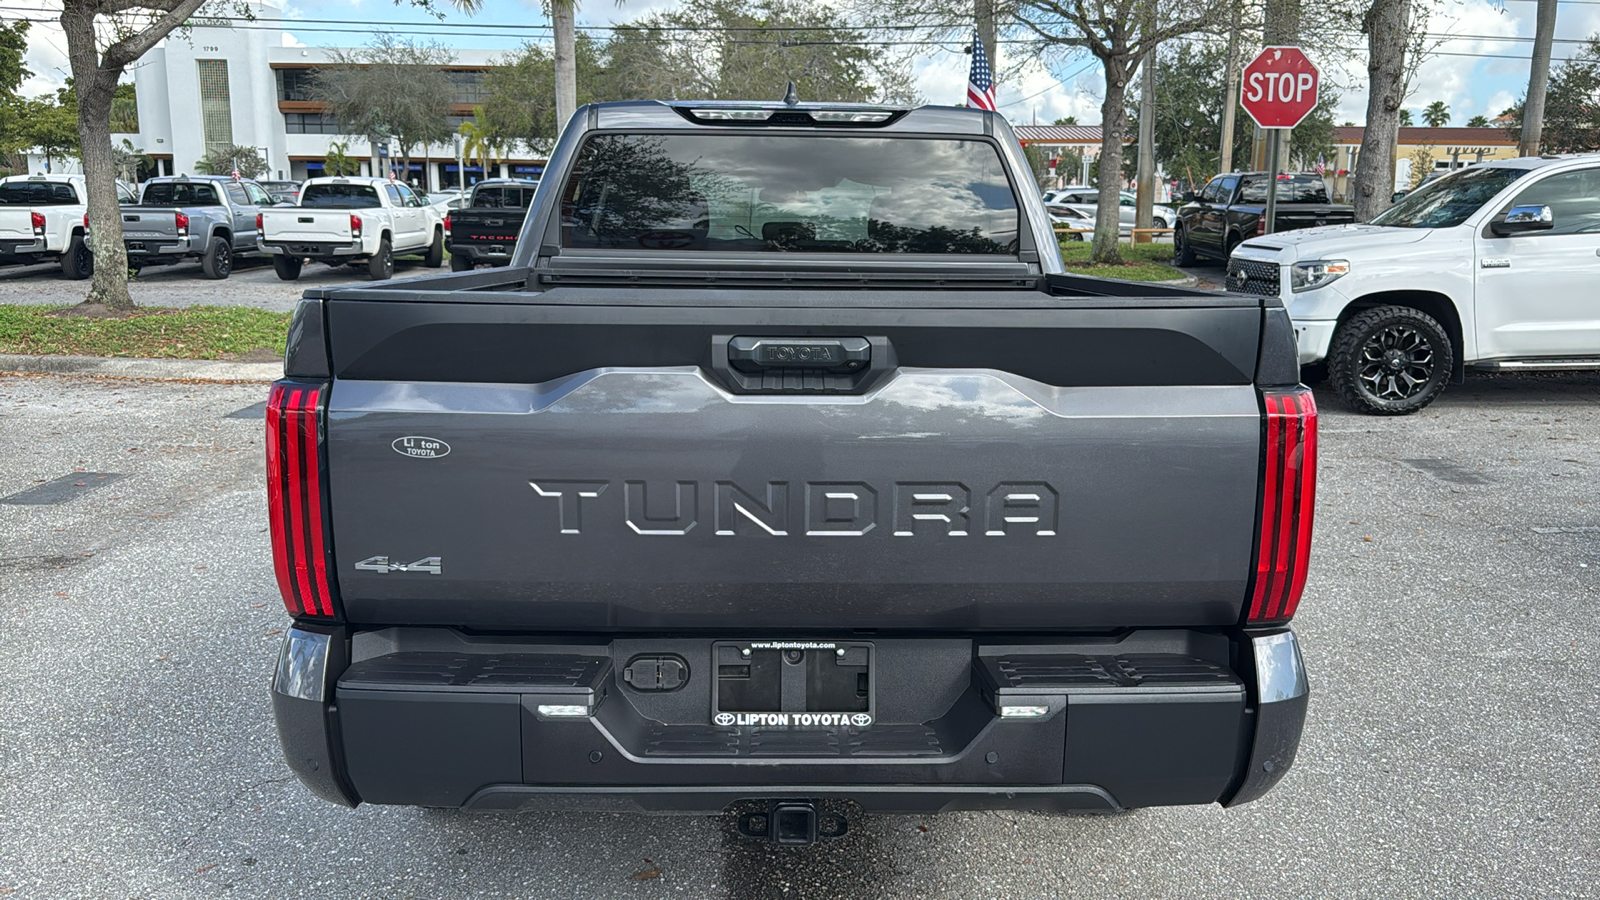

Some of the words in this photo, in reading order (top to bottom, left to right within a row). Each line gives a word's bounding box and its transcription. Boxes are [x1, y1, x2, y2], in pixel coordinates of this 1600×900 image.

[1247, 72, 1313, 102] STOP
[767, 347, 832, 360] TOYOTA
[404, 438, 440, 449] Liton
[407, 448, 436, 456] TOYOTA
[528, 479, 1059, 536] TUNDRA
[737, 713, 788, 725] LIPTON
[792, 713, 850, 725] TOYOTA
